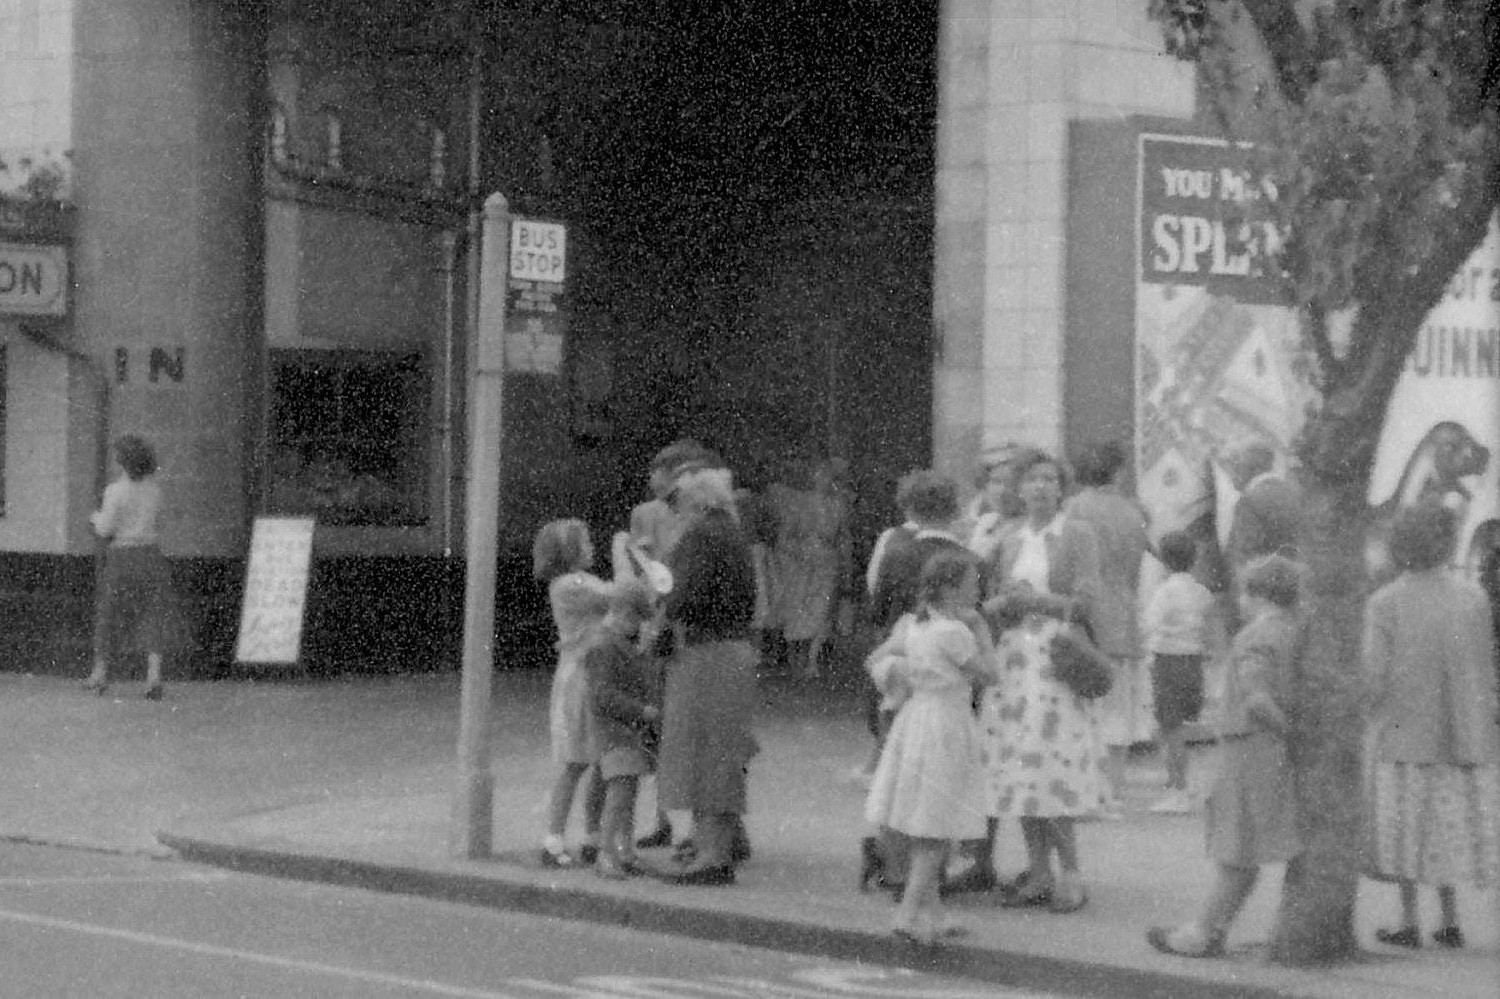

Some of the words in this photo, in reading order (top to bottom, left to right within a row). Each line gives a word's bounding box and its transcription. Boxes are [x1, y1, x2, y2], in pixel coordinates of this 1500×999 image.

[1161, 167, 1213, 199] YOU
[519, 227, 558, 249] BUS
[513, 250, 562, 274] STOP
[115, 345, 185, 384] IN
